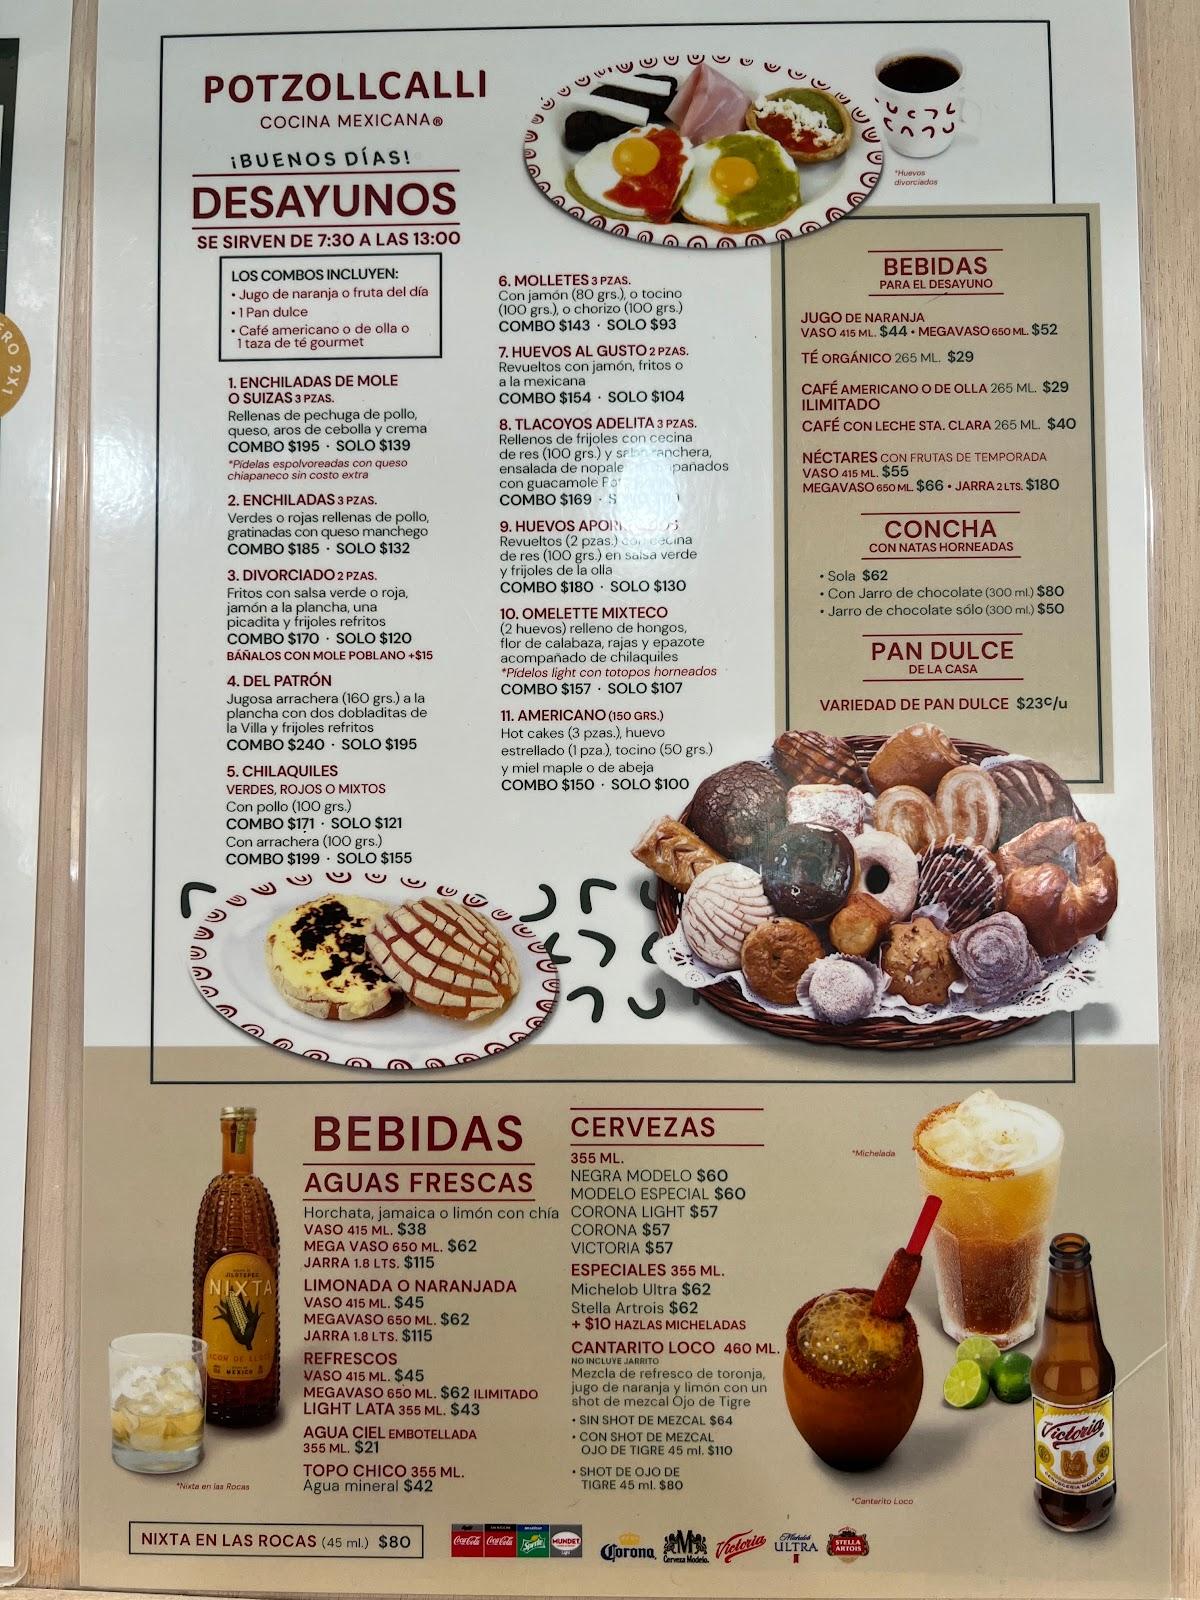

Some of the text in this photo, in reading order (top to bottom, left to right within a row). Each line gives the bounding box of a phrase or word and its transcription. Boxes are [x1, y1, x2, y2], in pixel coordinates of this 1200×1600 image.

[204, 69, 486, 103] POTZOLLCALLI
[259, 114, 330, 129] COCINA
[230, 148, 410, 169] ¡BUENOS DÍAS!
[192, 181, 456, 219] DESAYUNOS
[197, 230, 460, 249] SE SIRVEN DE 7:30 A LAS 13:00
[884, 256, 987, 276] BEBIDAS
[231, 267, 398, 282] LOS COMBOS INCLUYEN:
[498, 273, 631, 287] 6. MOLLETES 3 PZAS.
[879, 278, 993, 289] PARA EL DESAYUNO
[239, 306, 308, 318] 1 Pan dulce
[800, 311, 925, 324] JUGO DE NARANJA
[800, 323, 1058, 338] VASO 415 ML. $44 MEGAVASO 650 ML. $52
[228, 374, 398, 389] 1. ENCHILADAS DE MOLE
[228, 391, 334, 404] O SUIZAS 3 PZAS.
[227, 439, 410, 453] COMBO $195 SOLO $139
[272, 458, 349, 470] espolvoreadas
[352, 459, 372, 468] con
[374, 459, 408, 469] queso
[226, 470, 368, 482] chiapaneco sin costo extra
[884, 519, 997, 539] CONCHA
[868, 541, 1014, 553] CON NATAS HORNEADAS
[499, 606, 668, 620] 10. OMELETTE MIXTECO
[226, 648, 433, 661] BÁÑALOS CON MOLE POBLANO +$15
[871, 640, 1014, 660] PAN DULCE
[551, 666, 576, 680] light
[579, 669, 602, 678] con
[605, 668, 650, 679] totopos
[653, 665, 717, 677] horneados
[908, 663, 978, 674] DE LA CASA
[226, 672, 332, 687] 4. DEL PATRÓN
[819, 698, 896, 711] VARIEDAD
[900, 698, 920, 710] DE
[924, 698, 954, 710] PAN
[958, 697, 1008, 710] DULCE
[226, 764, 338, 779] 5. CHILAQUILES
[314, 1114, 522, 1152] BEBIDAS
[570, 1116, 715, 1138] CERVEZAS
[304, 1171, 532, 1193] AGUAS FRESCAS
[570, 1168, 728, 1183] NEGRA MODELO $60
[209, 1278, 272, 1297] NIXTA
[304, 1278, 517, 1293] LIMONADA O NARANJADA
[571, 1301, 698, 1315] Stella Artrois $62
[571, 1340, 780, 1354] CANTARITO LOCO 460 ML.
[304, 1351, 397, 1365] REFRESCOS
[586, 1357, 622, 1365] INCLUYE
[302, 1425, 477, 1440] AGUA CIEL EMBOTELLADA
[1041, 1415, 1104, 1450] Victoria
[141, 1532, 411, 1550] NIXTA EN LAS ROCAS (45 ml.) $80
[716, 1529, 767, 1563] Victoria
[774, 1541, 818, 1552] ULTRA
[663, 1555, 686, 1563] Cerveza
